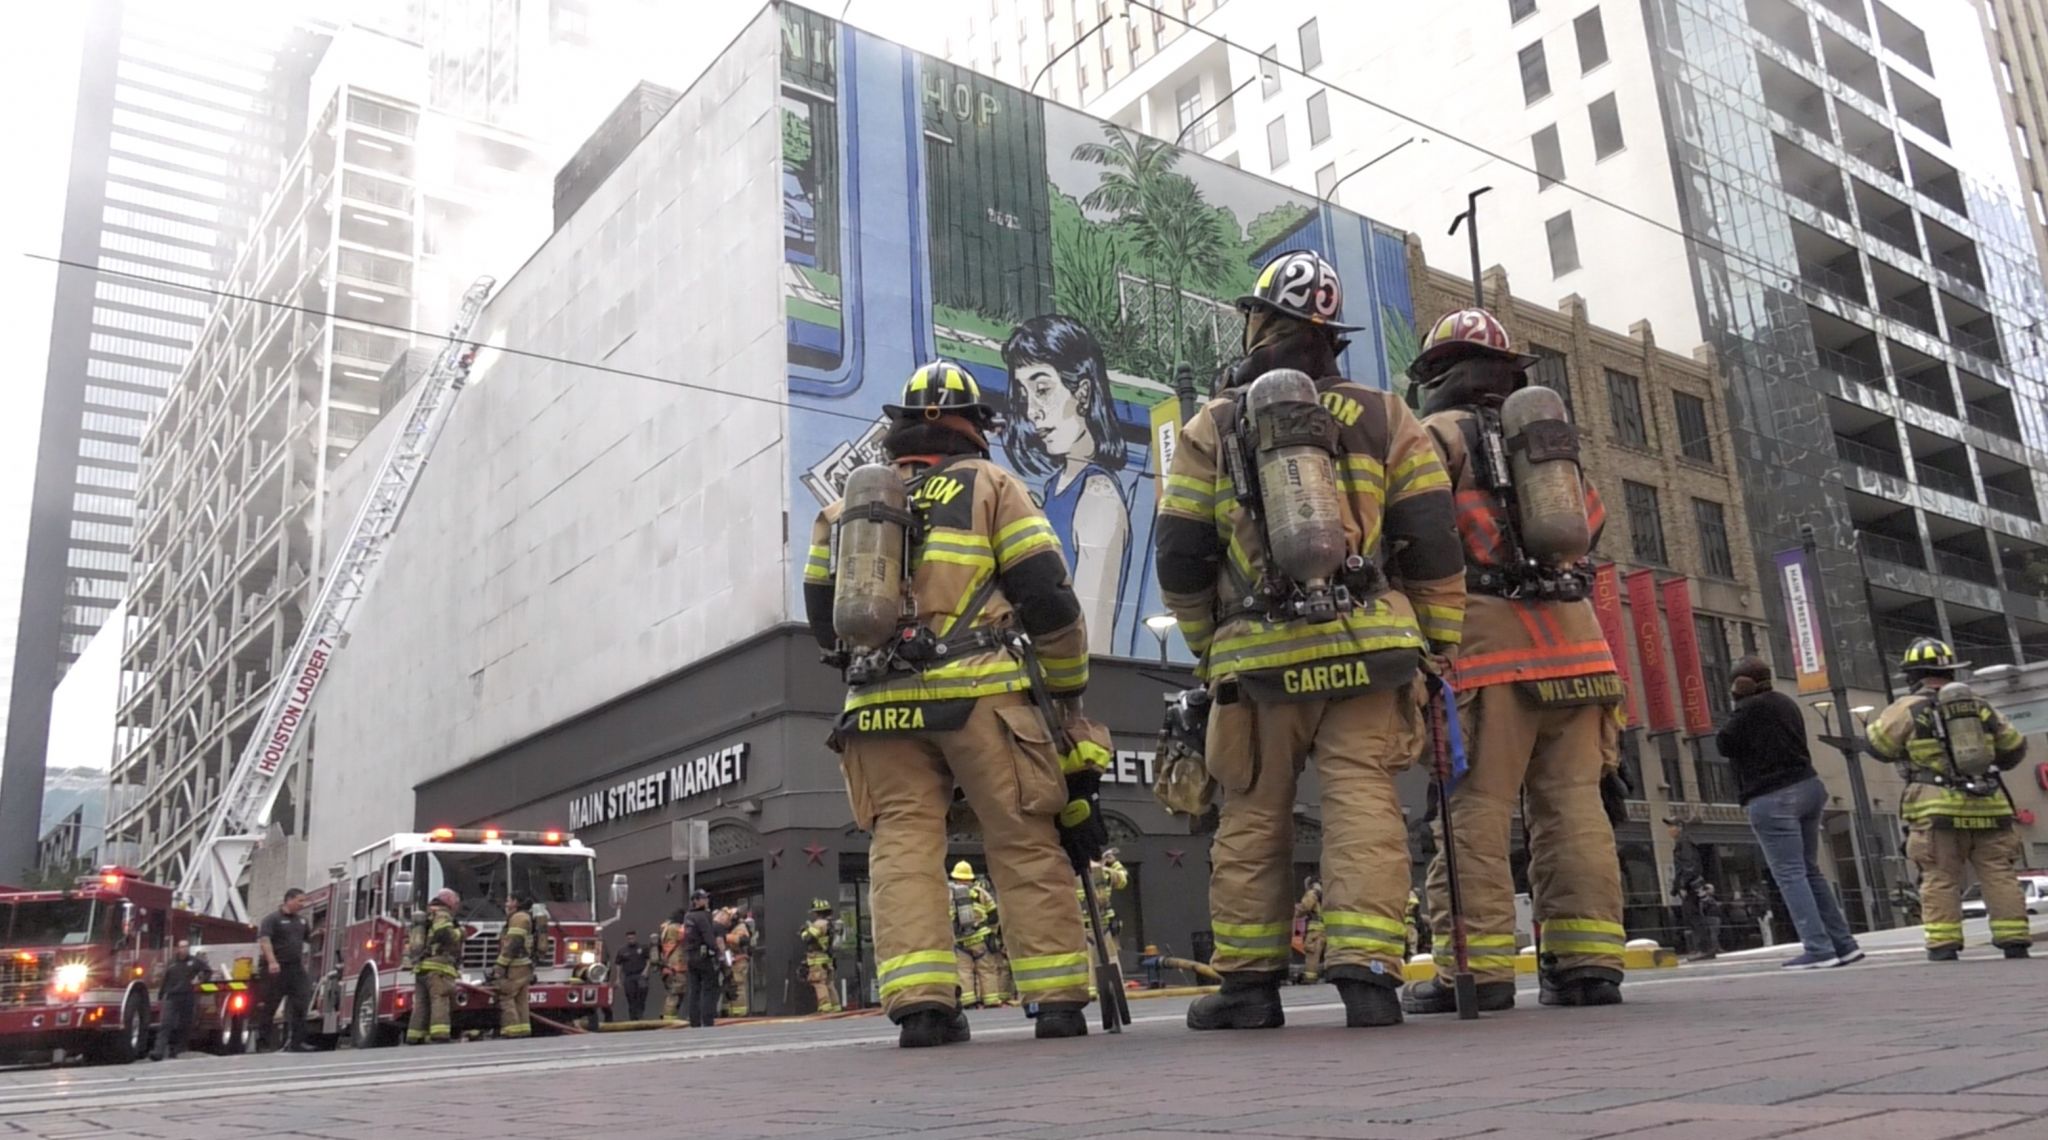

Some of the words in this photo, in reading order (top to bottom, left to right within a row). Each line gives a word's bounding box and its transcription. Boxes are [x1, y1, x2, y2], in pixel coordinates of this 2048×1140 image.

[1278, 258, 1339, 317] 25
[937, 387, 949, 405] 7
[1597, 570, 1617, 612] Holy
[1641, 623, 1659, 666] Cross
[1794, 594, 1808, 628] STREET
[1801, 630, 1815, 668] SQUARE
[1283, 660, 1371, 693] GARCIA
[258, 704, 302, 773] HOUSTON
[291, 649, 329, 706] LADDER
[317, 638, 333, 650] 7
[858, 706, 925, 731] GARZA
[1684, 675, 1710, 729] Chapel
[568, 790, 604, 831] MAIN
[607, 770, 667, 820] STREET
[670, 742, 745, 802] MARKET
[1953, 816, 1999, 829] BERNAL
[76, 1008, 86, 1028] 7
